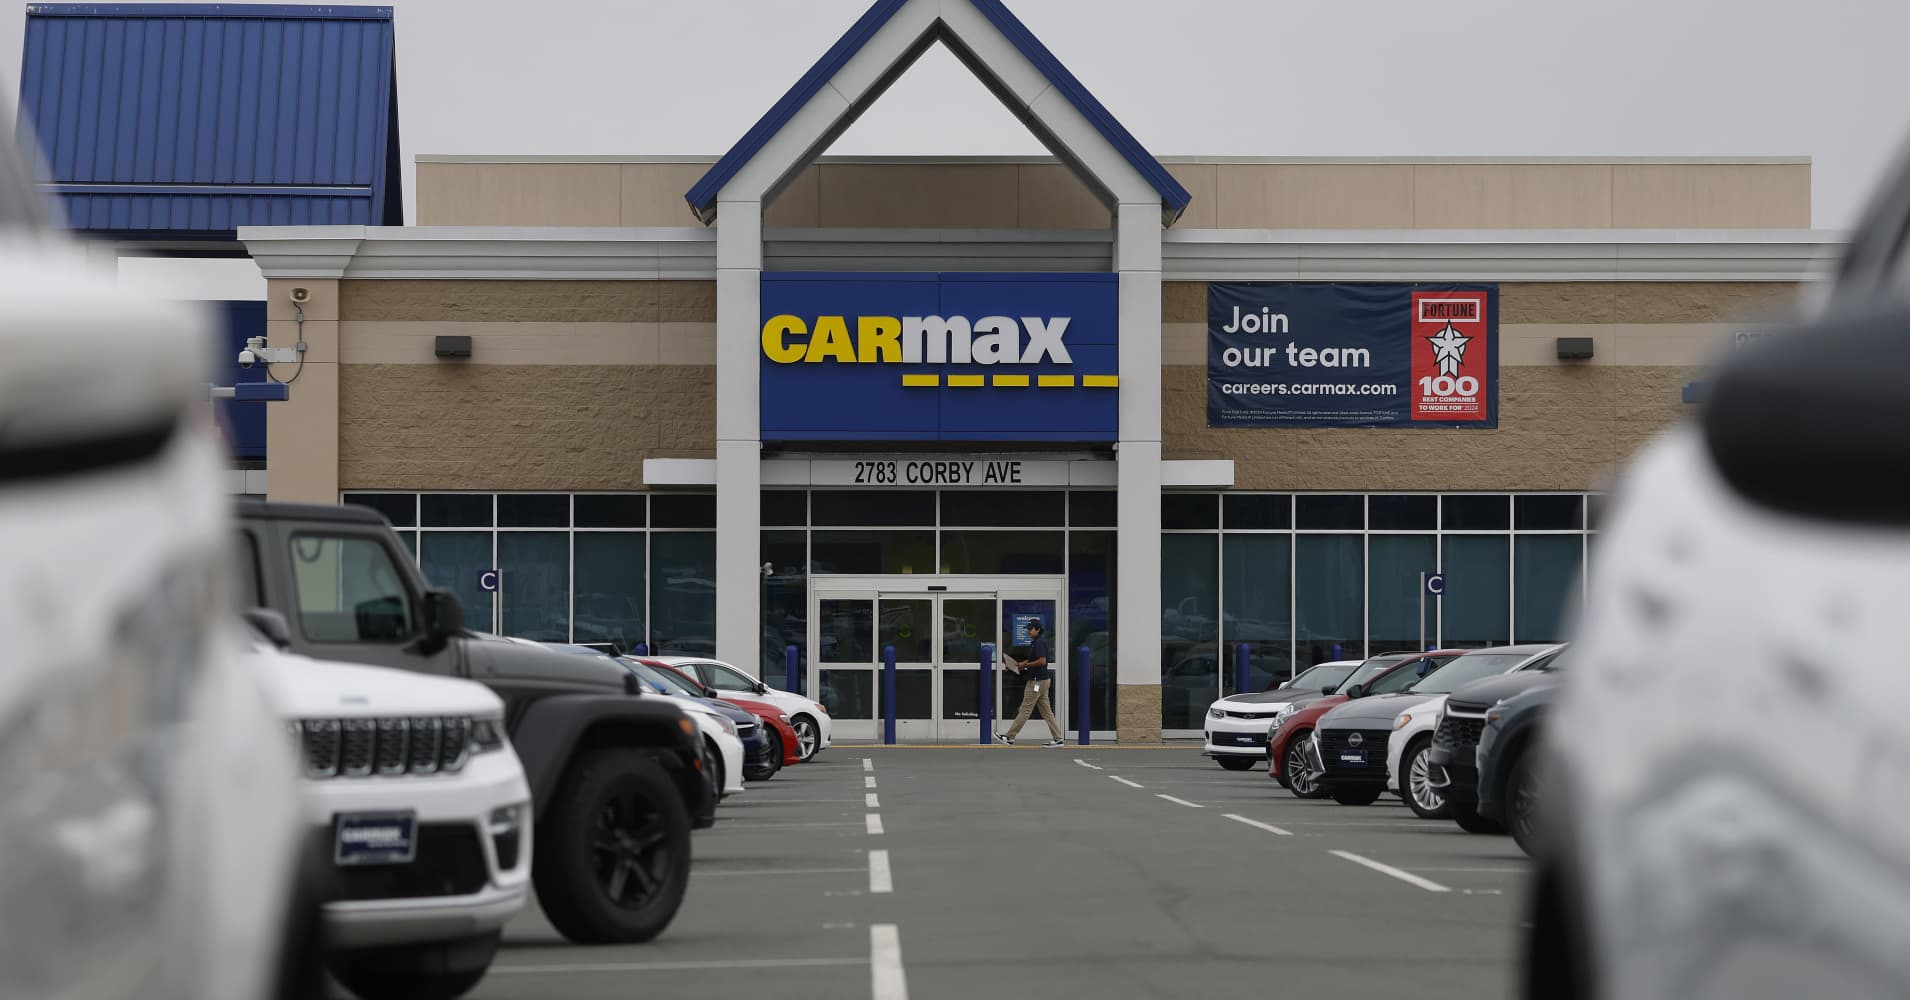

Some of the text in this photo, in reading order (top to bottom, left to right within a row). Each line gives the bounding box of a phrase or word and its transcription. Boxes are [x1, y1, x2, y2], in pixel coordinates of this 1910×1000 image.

[1222, 305, 1289, 334] Join
[1424, 303, 1475, 317] FORTUNE
[1222, 341, 1370, 368] our team
[1222, 382, 1397, 396] careers.carmax.com
[1418, 376, 1479, 396] 100
[855, 461, 1022, 484] 2783 CORBY AVE
[480, 572, 496, 590] C
[1428, 575, 1443, 593] C
